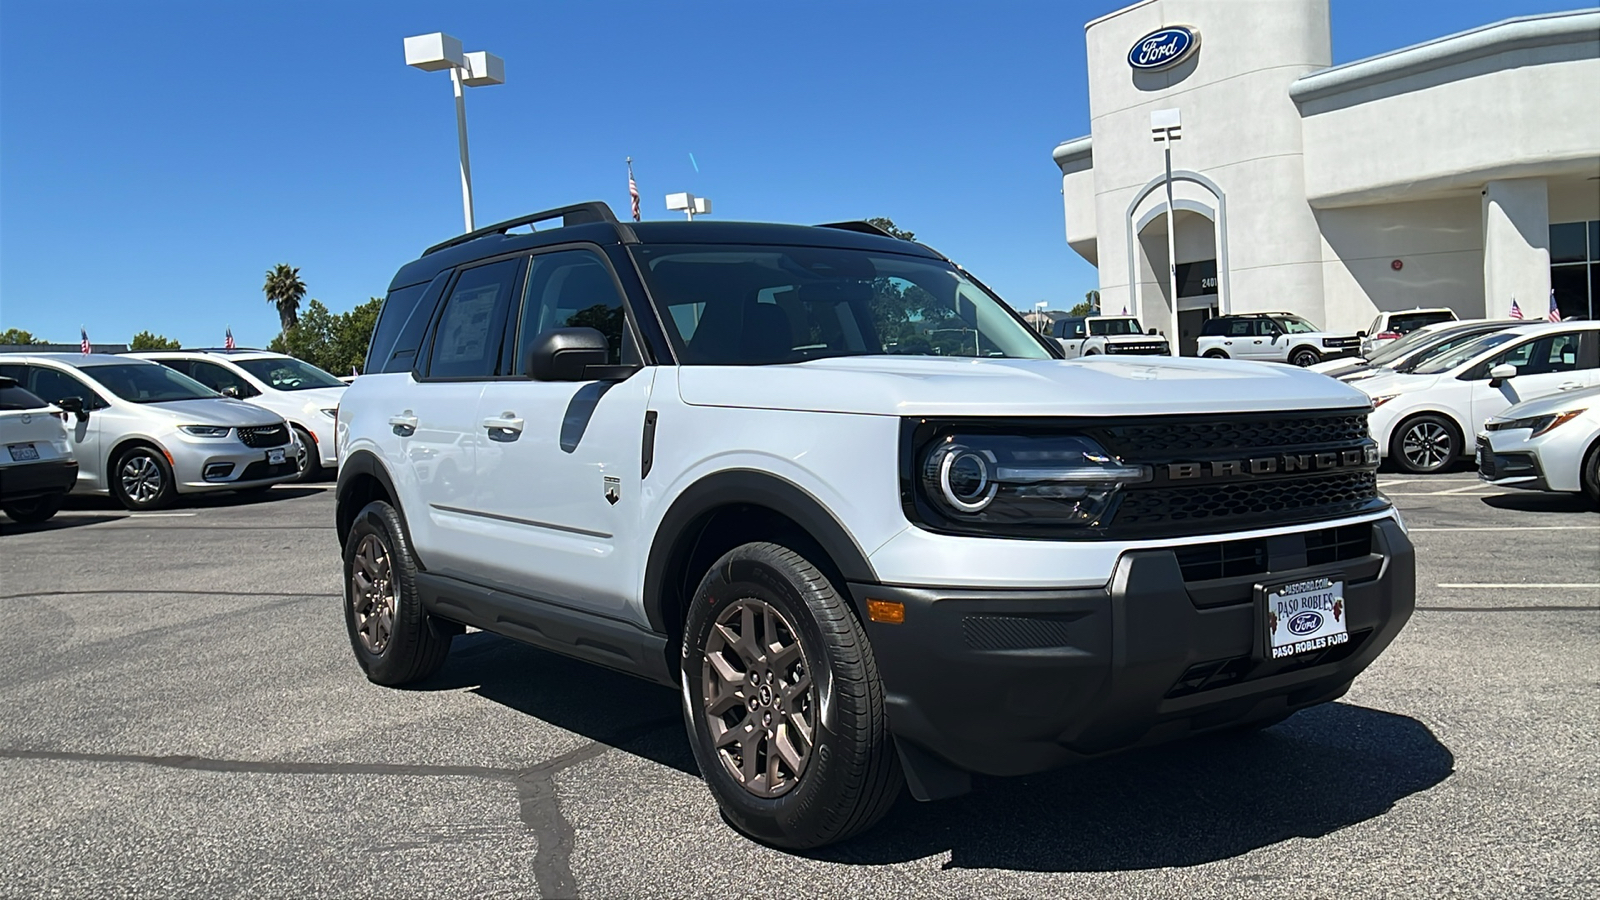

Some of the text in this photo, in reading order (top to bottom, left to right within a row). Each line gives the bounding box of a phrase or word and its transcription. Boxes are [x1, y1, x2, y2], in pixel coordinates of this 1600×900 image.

[1139, 34, 1179, 64] Ford
[1202, 277, 1217, 288] 2401
[1167, 450, 1362, 480] BRONCO
[1285, 578, 1329, 595] PASOFORD.COM
[1277, 592, 1334, 621] PASO ROBLES
[1294, 615, 1318, 632] Ford
[1272, 632, 1349, 659] PASO ROBLES FORD
